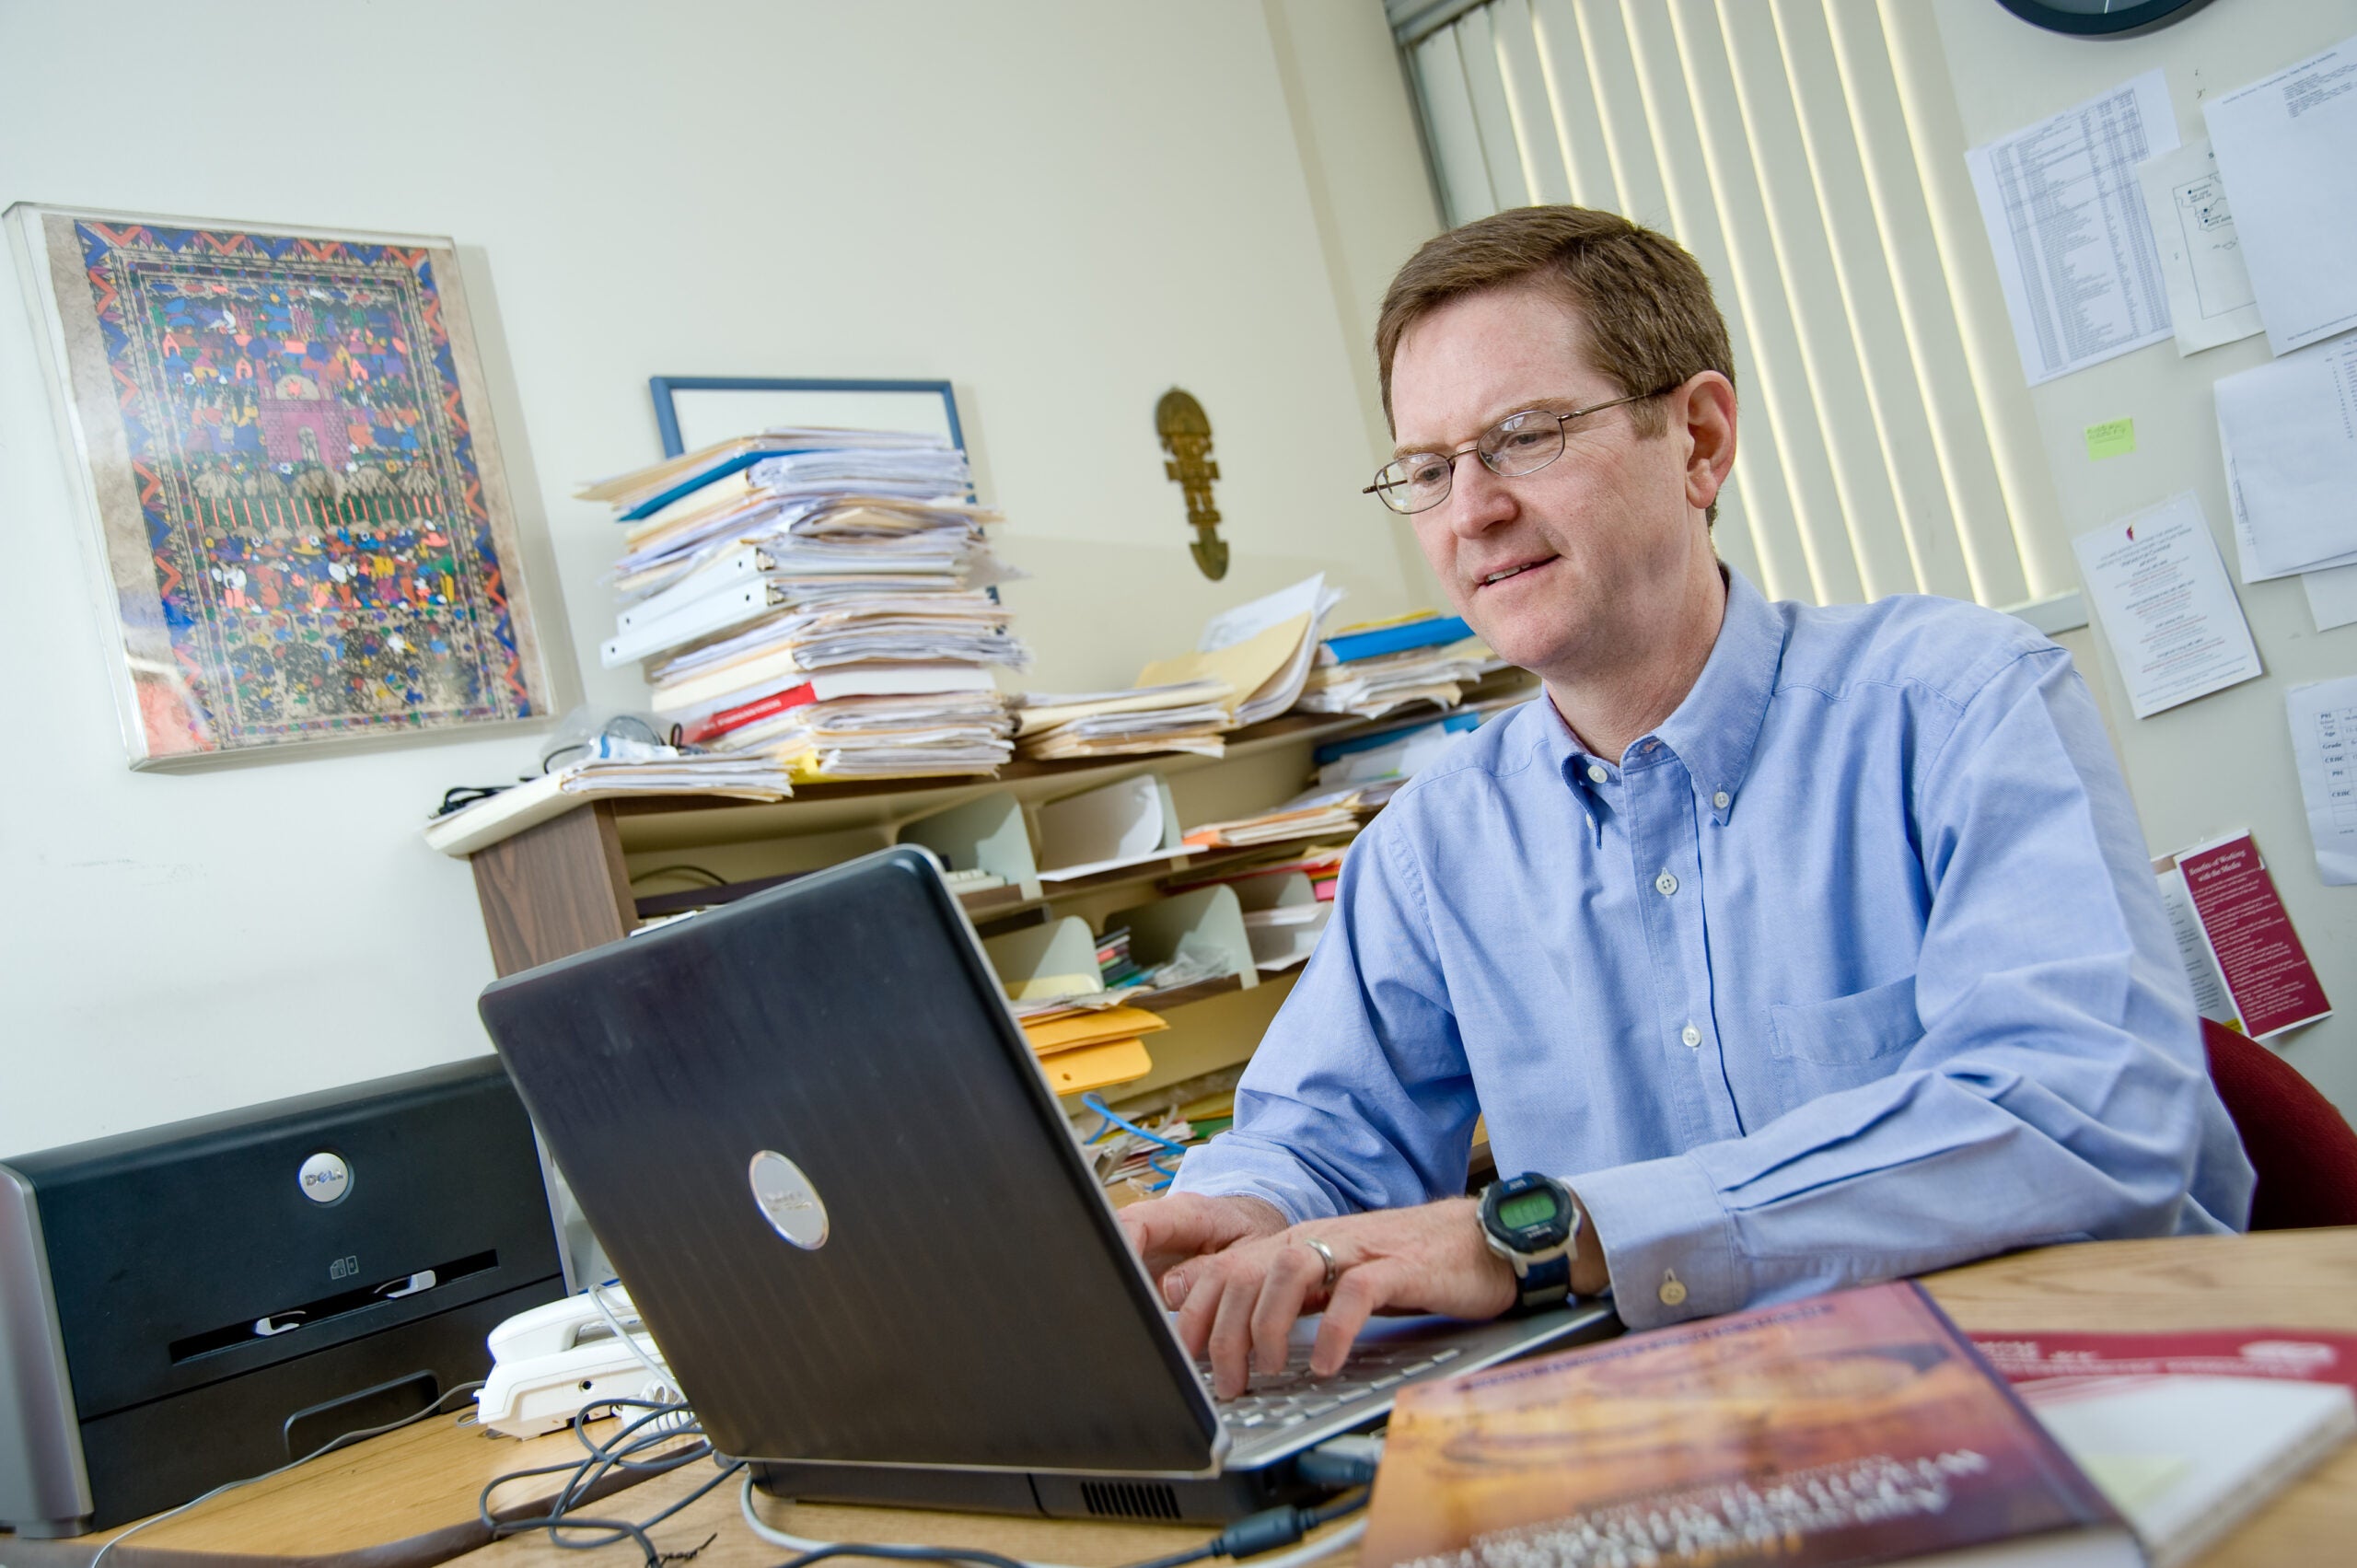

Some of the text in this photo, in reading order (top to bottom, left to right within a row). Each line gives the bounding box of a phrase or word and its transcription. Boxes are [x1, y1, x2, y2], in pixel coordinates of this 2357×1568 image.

[2189, 862, 2212, 877] Benefits
[2219, 850, 2247, 864] Working
[2198, 872, 2211, 882] with
[2222, 861, 2242, 873] Media
[305, 1169, 343, 1186] DELL
